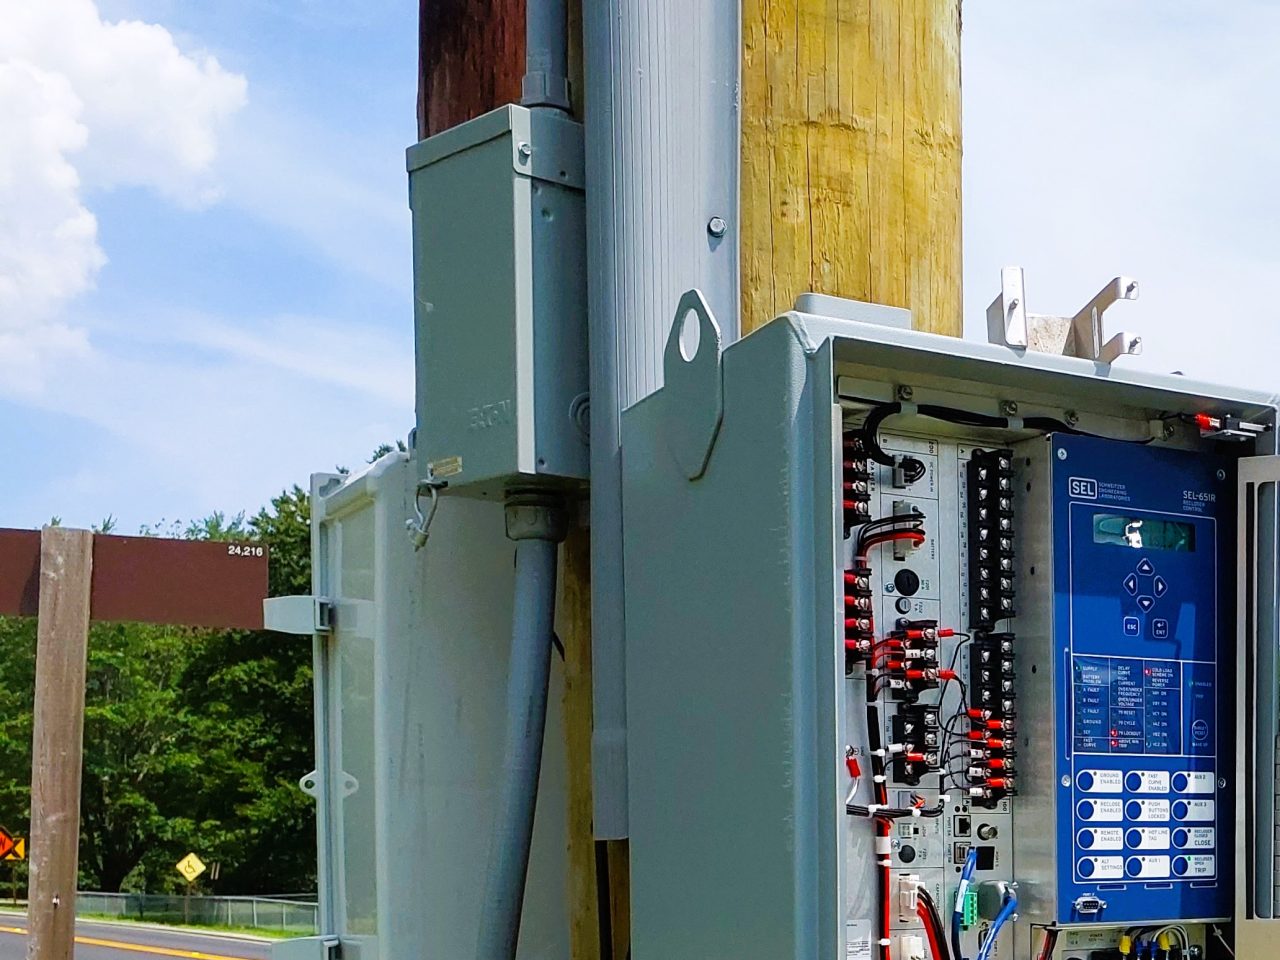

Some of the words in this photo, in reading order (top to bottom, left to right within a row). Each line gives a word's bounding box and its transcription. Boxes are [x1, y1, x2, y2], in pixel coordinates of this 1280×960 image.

[1072, 481, 1095, 496] SEL
[1183, 490, 1216, 502] SEL-651R
[228, 545, 263, 557] 24,216
